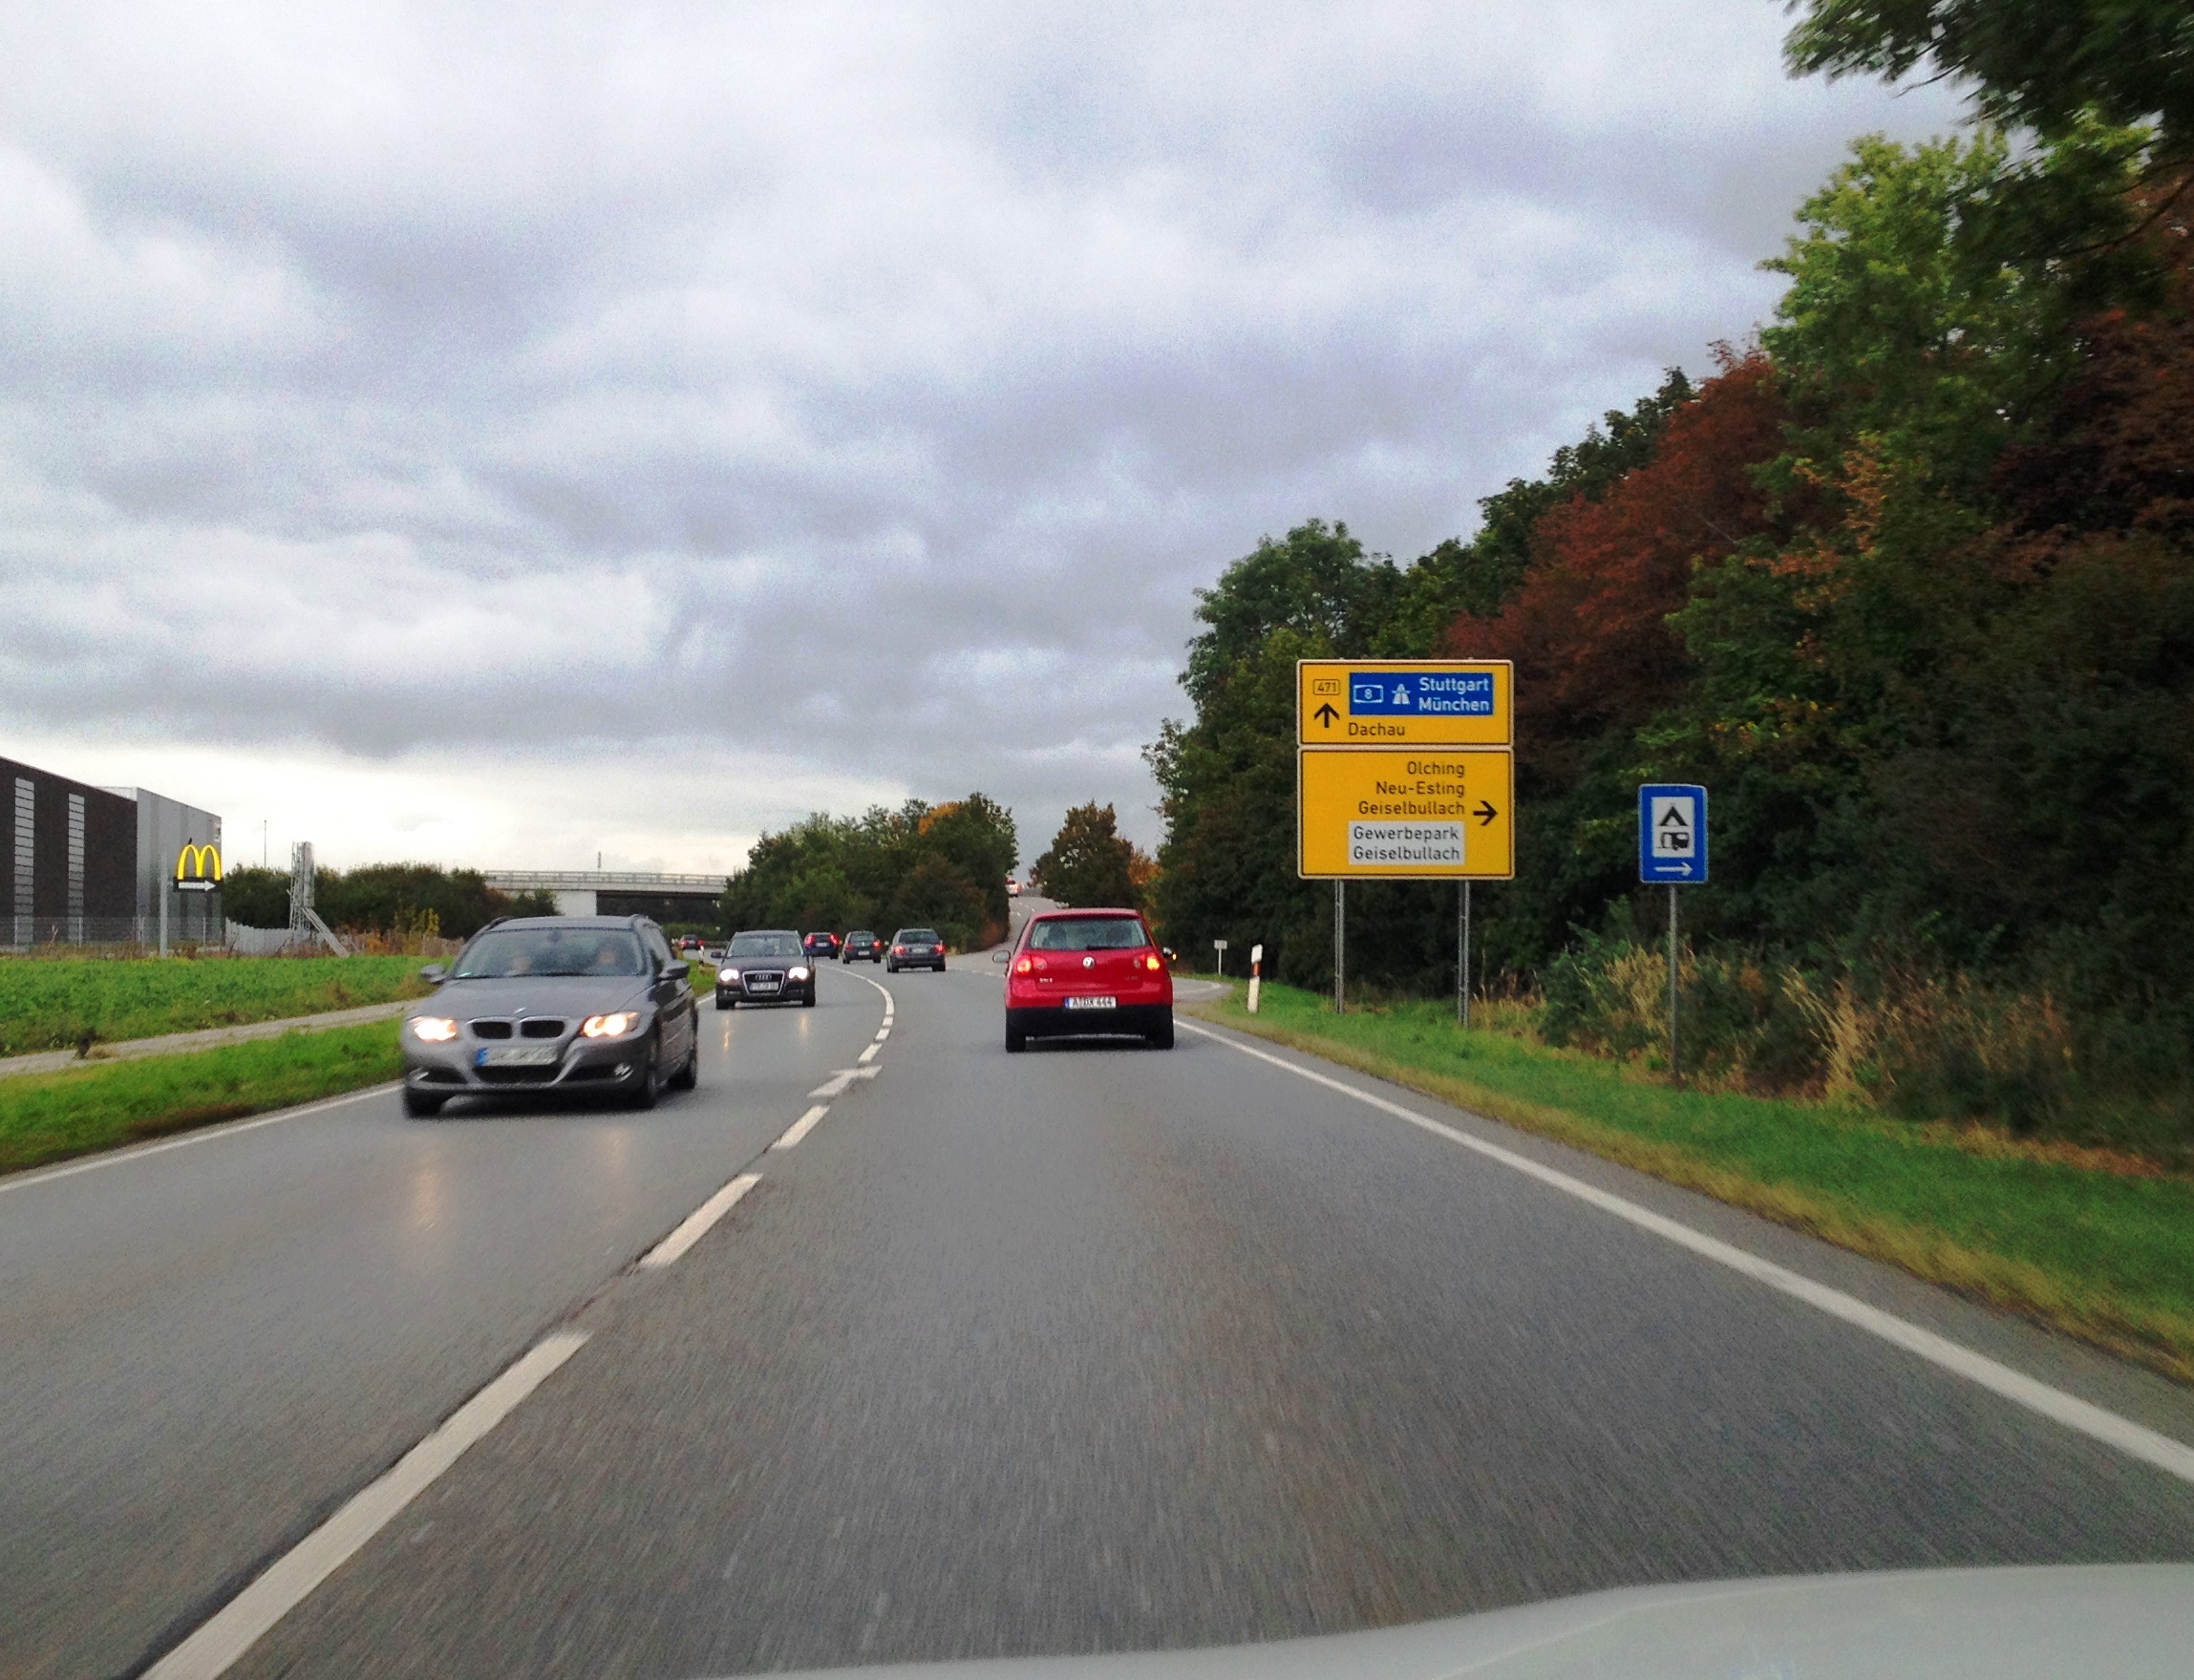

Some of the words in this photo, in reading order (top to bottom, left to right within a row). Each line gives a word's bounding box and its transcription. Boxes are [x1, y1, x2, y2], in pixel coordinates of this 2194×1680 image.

[1316, 681, 1336, 692] 471
[1418, 677, 1489, 694] Stuttgart
[1364, 688, 1373, 699] 8
[1418, 697, 1490, 712] München
[1348, 722, 1405, 736] Dachau
[1407, 761, 1465, 778] Olching
[1375, 781, 1465, 797] Neu-Esting
[1358, 800, 1465, 815] Geiselbullach
[1353, 826, 1459, 842] Gewerbepark
[1353, 846, 1459, 860] Geiselbullach
